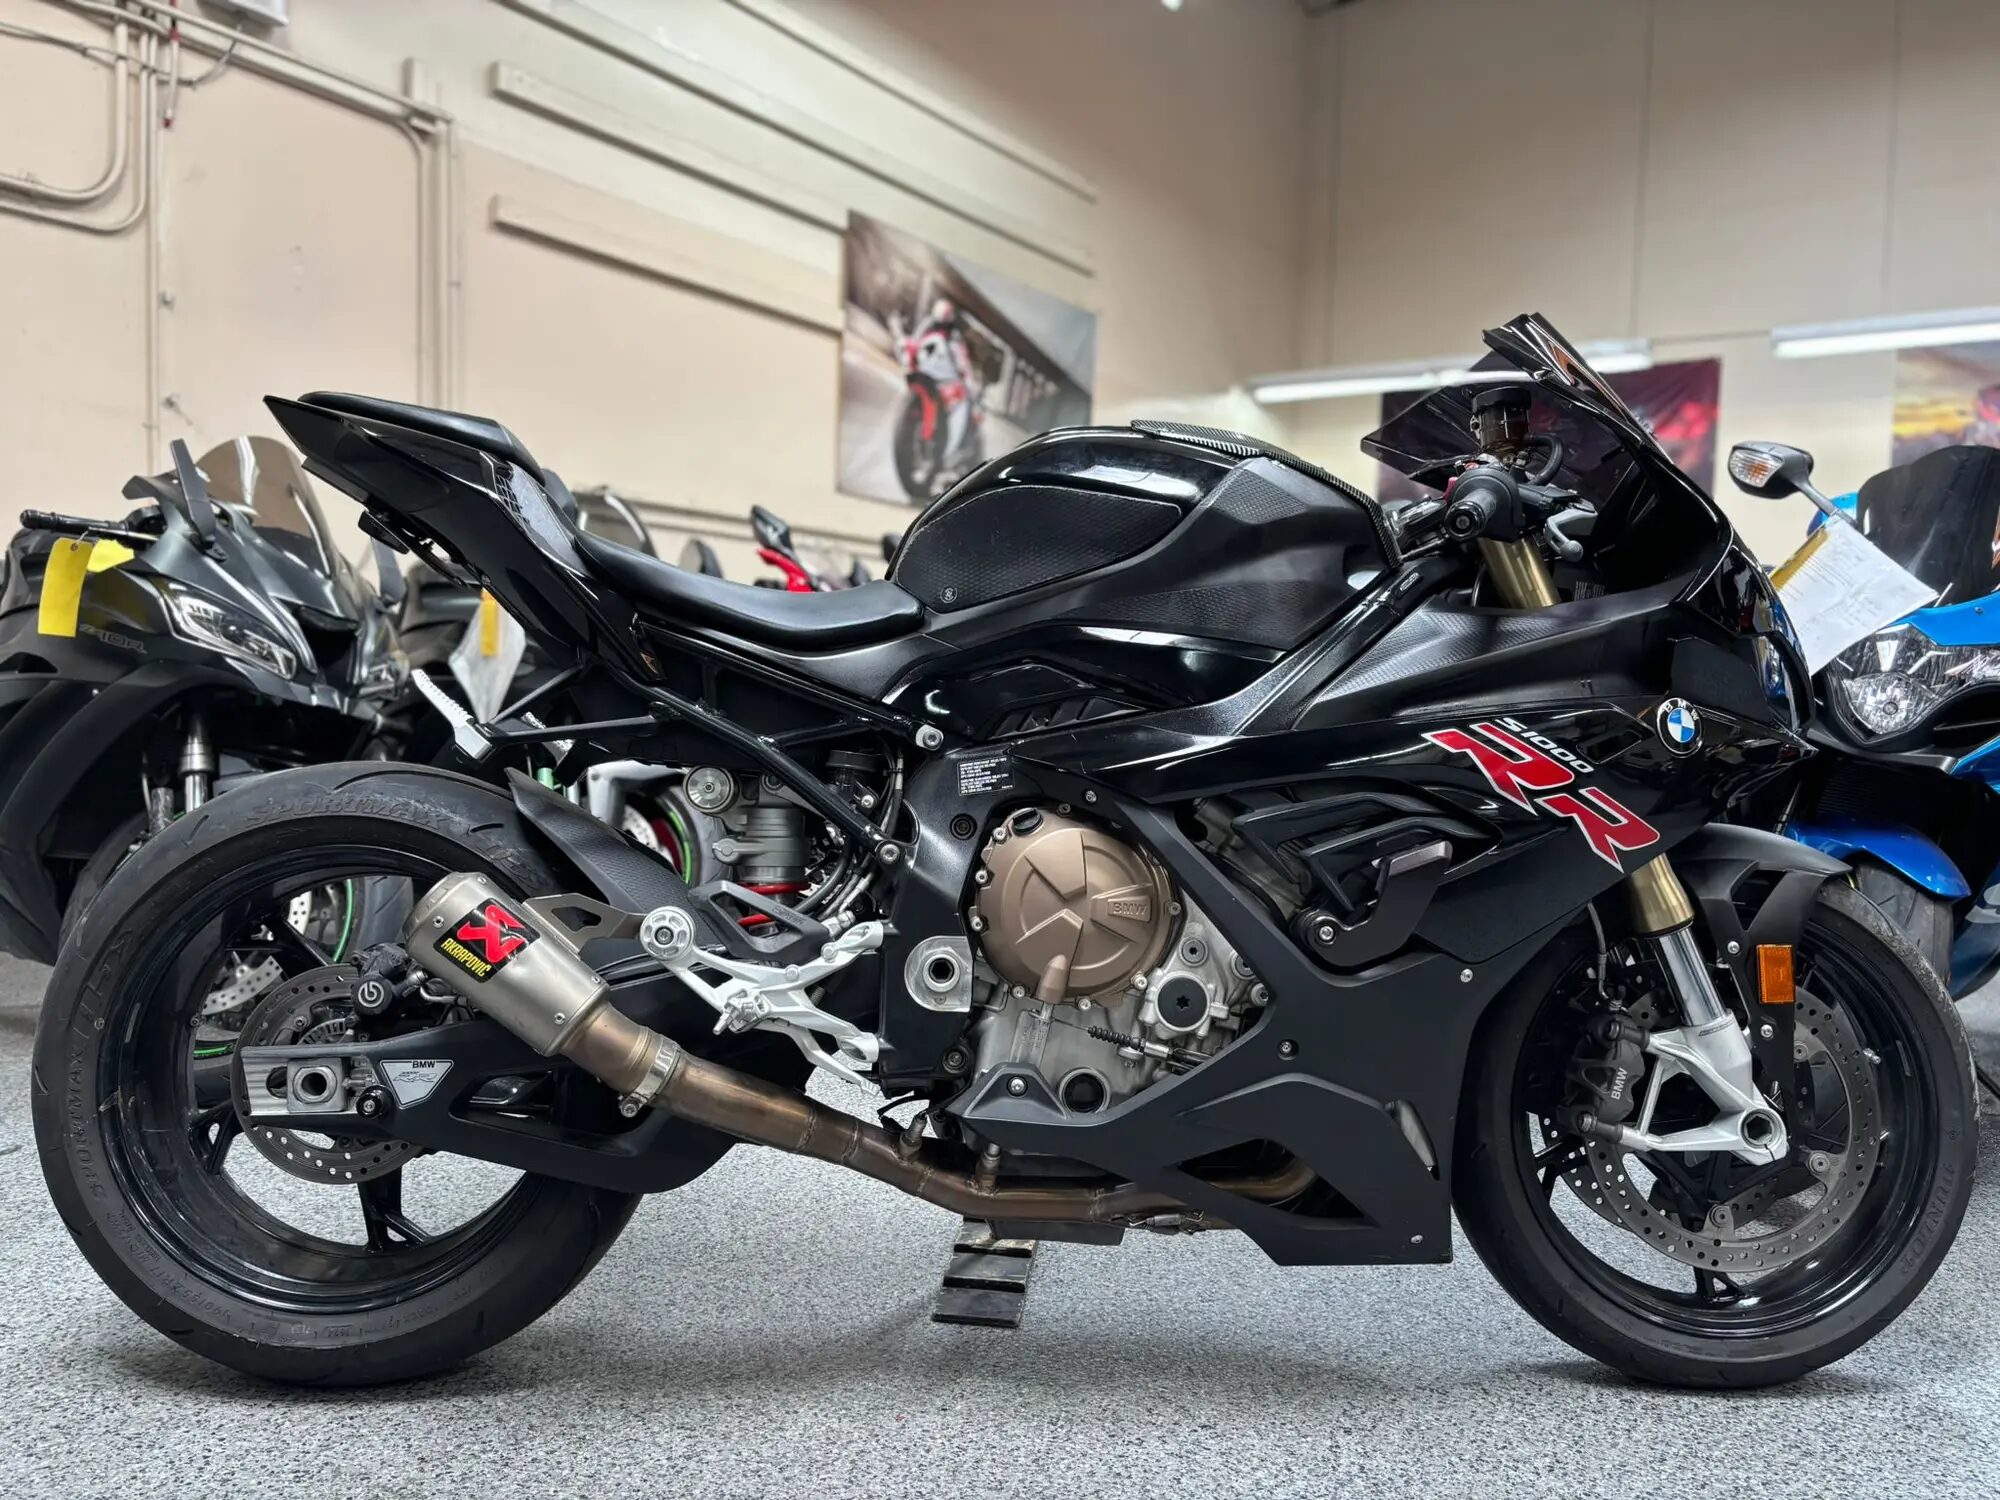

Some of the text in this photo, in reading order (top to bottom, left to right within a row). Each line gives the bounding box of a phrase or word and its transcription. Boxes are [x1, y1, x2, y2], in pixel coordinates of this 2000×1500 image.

[1663, 697, 1700, 721] BMW
[1495, 716, 1595, 774] S1000
[1420, 721, 1661, 874] RR
[1113, 902, 1147, 916] BMW
[412, 1060, 436, 1069] BMW
[1610, 1066, 1628, 1100] BMW
